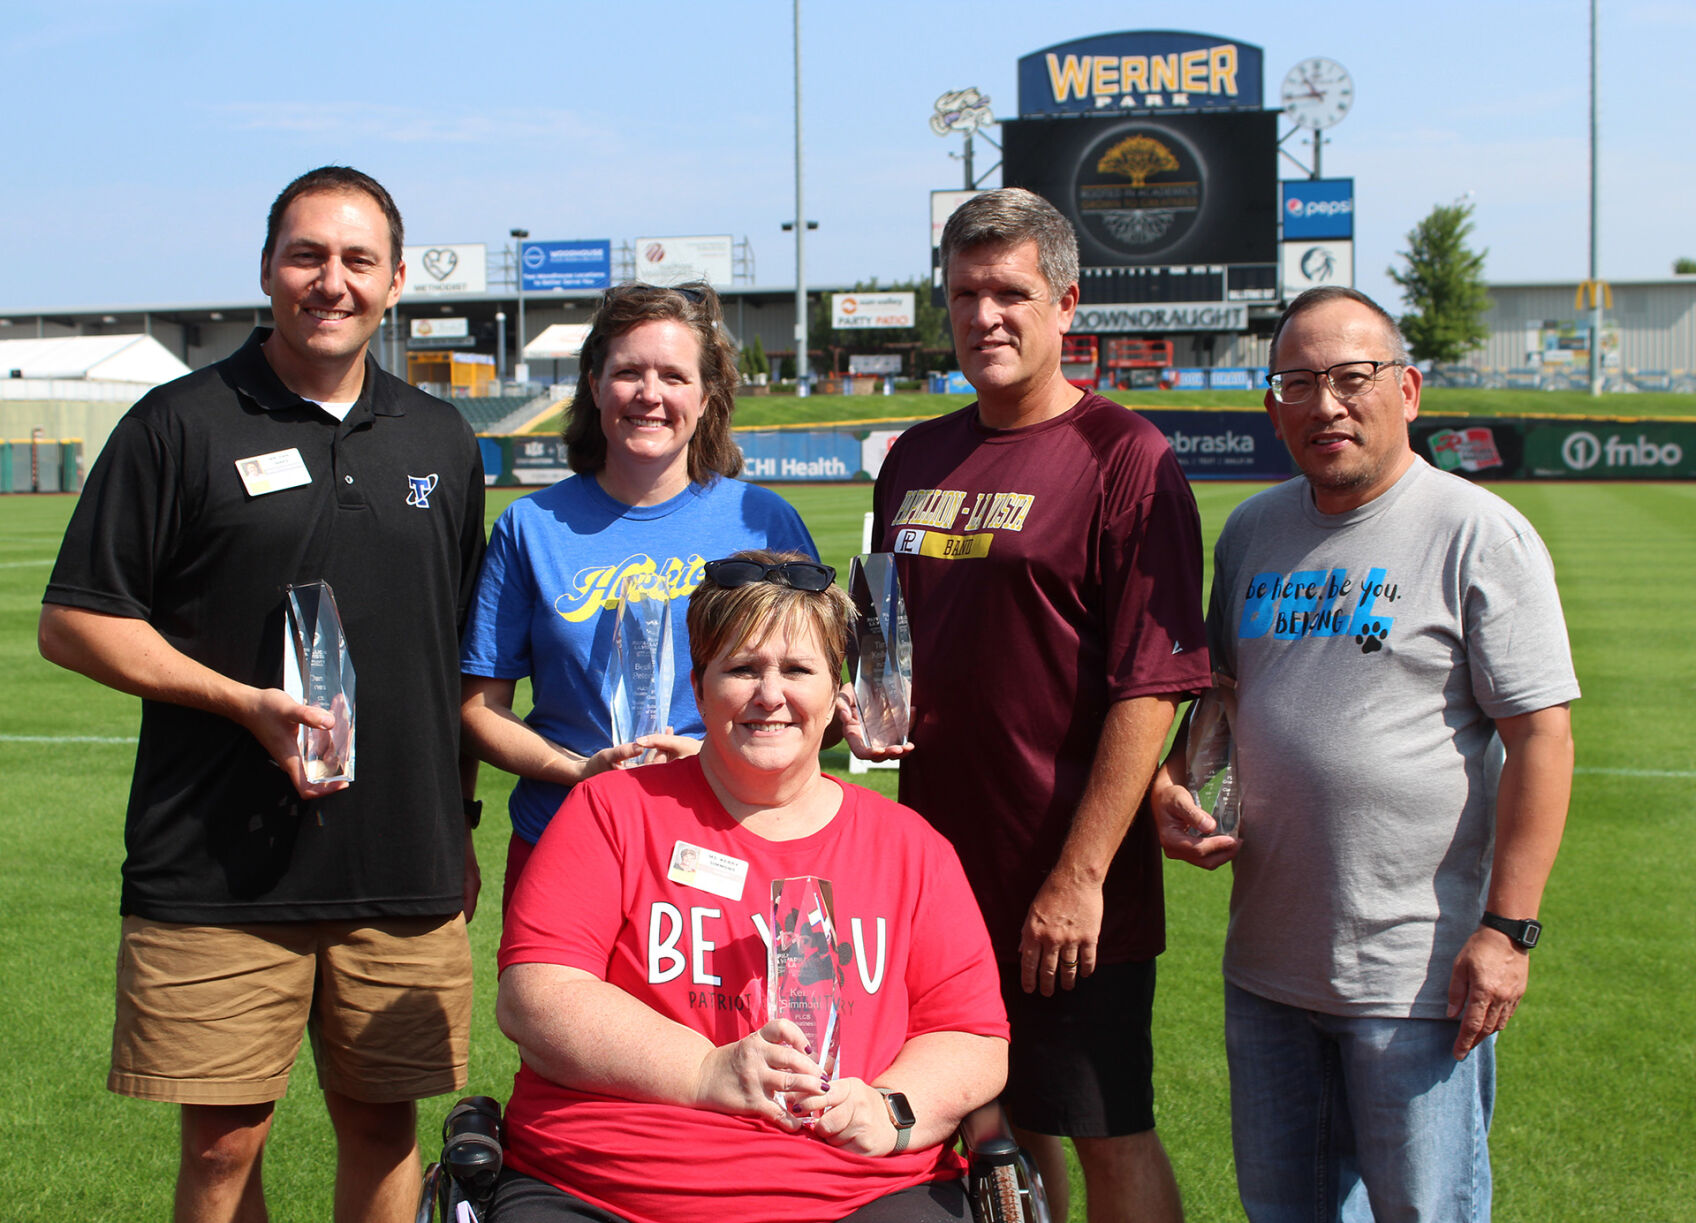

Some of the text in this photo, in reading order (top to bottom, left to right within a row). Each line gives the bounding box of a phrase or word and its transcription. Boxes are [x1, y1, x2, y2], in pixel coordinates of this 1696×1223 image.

[1045, 44, 1238, 104] WERNER
[1095, 93, 1190, 108] PARK
[1305, 198, 1353, 217] pepsi
[838, 314, 909, 325] PARTY PATIO
[1604, 434, 1682, 466] fnbo
[744, 456, 846, 477] CHI Health
[943, 538, 974, 556] BAND
[1328, 575, 1352, 599] be
[648, 901, 722, 986] BE
